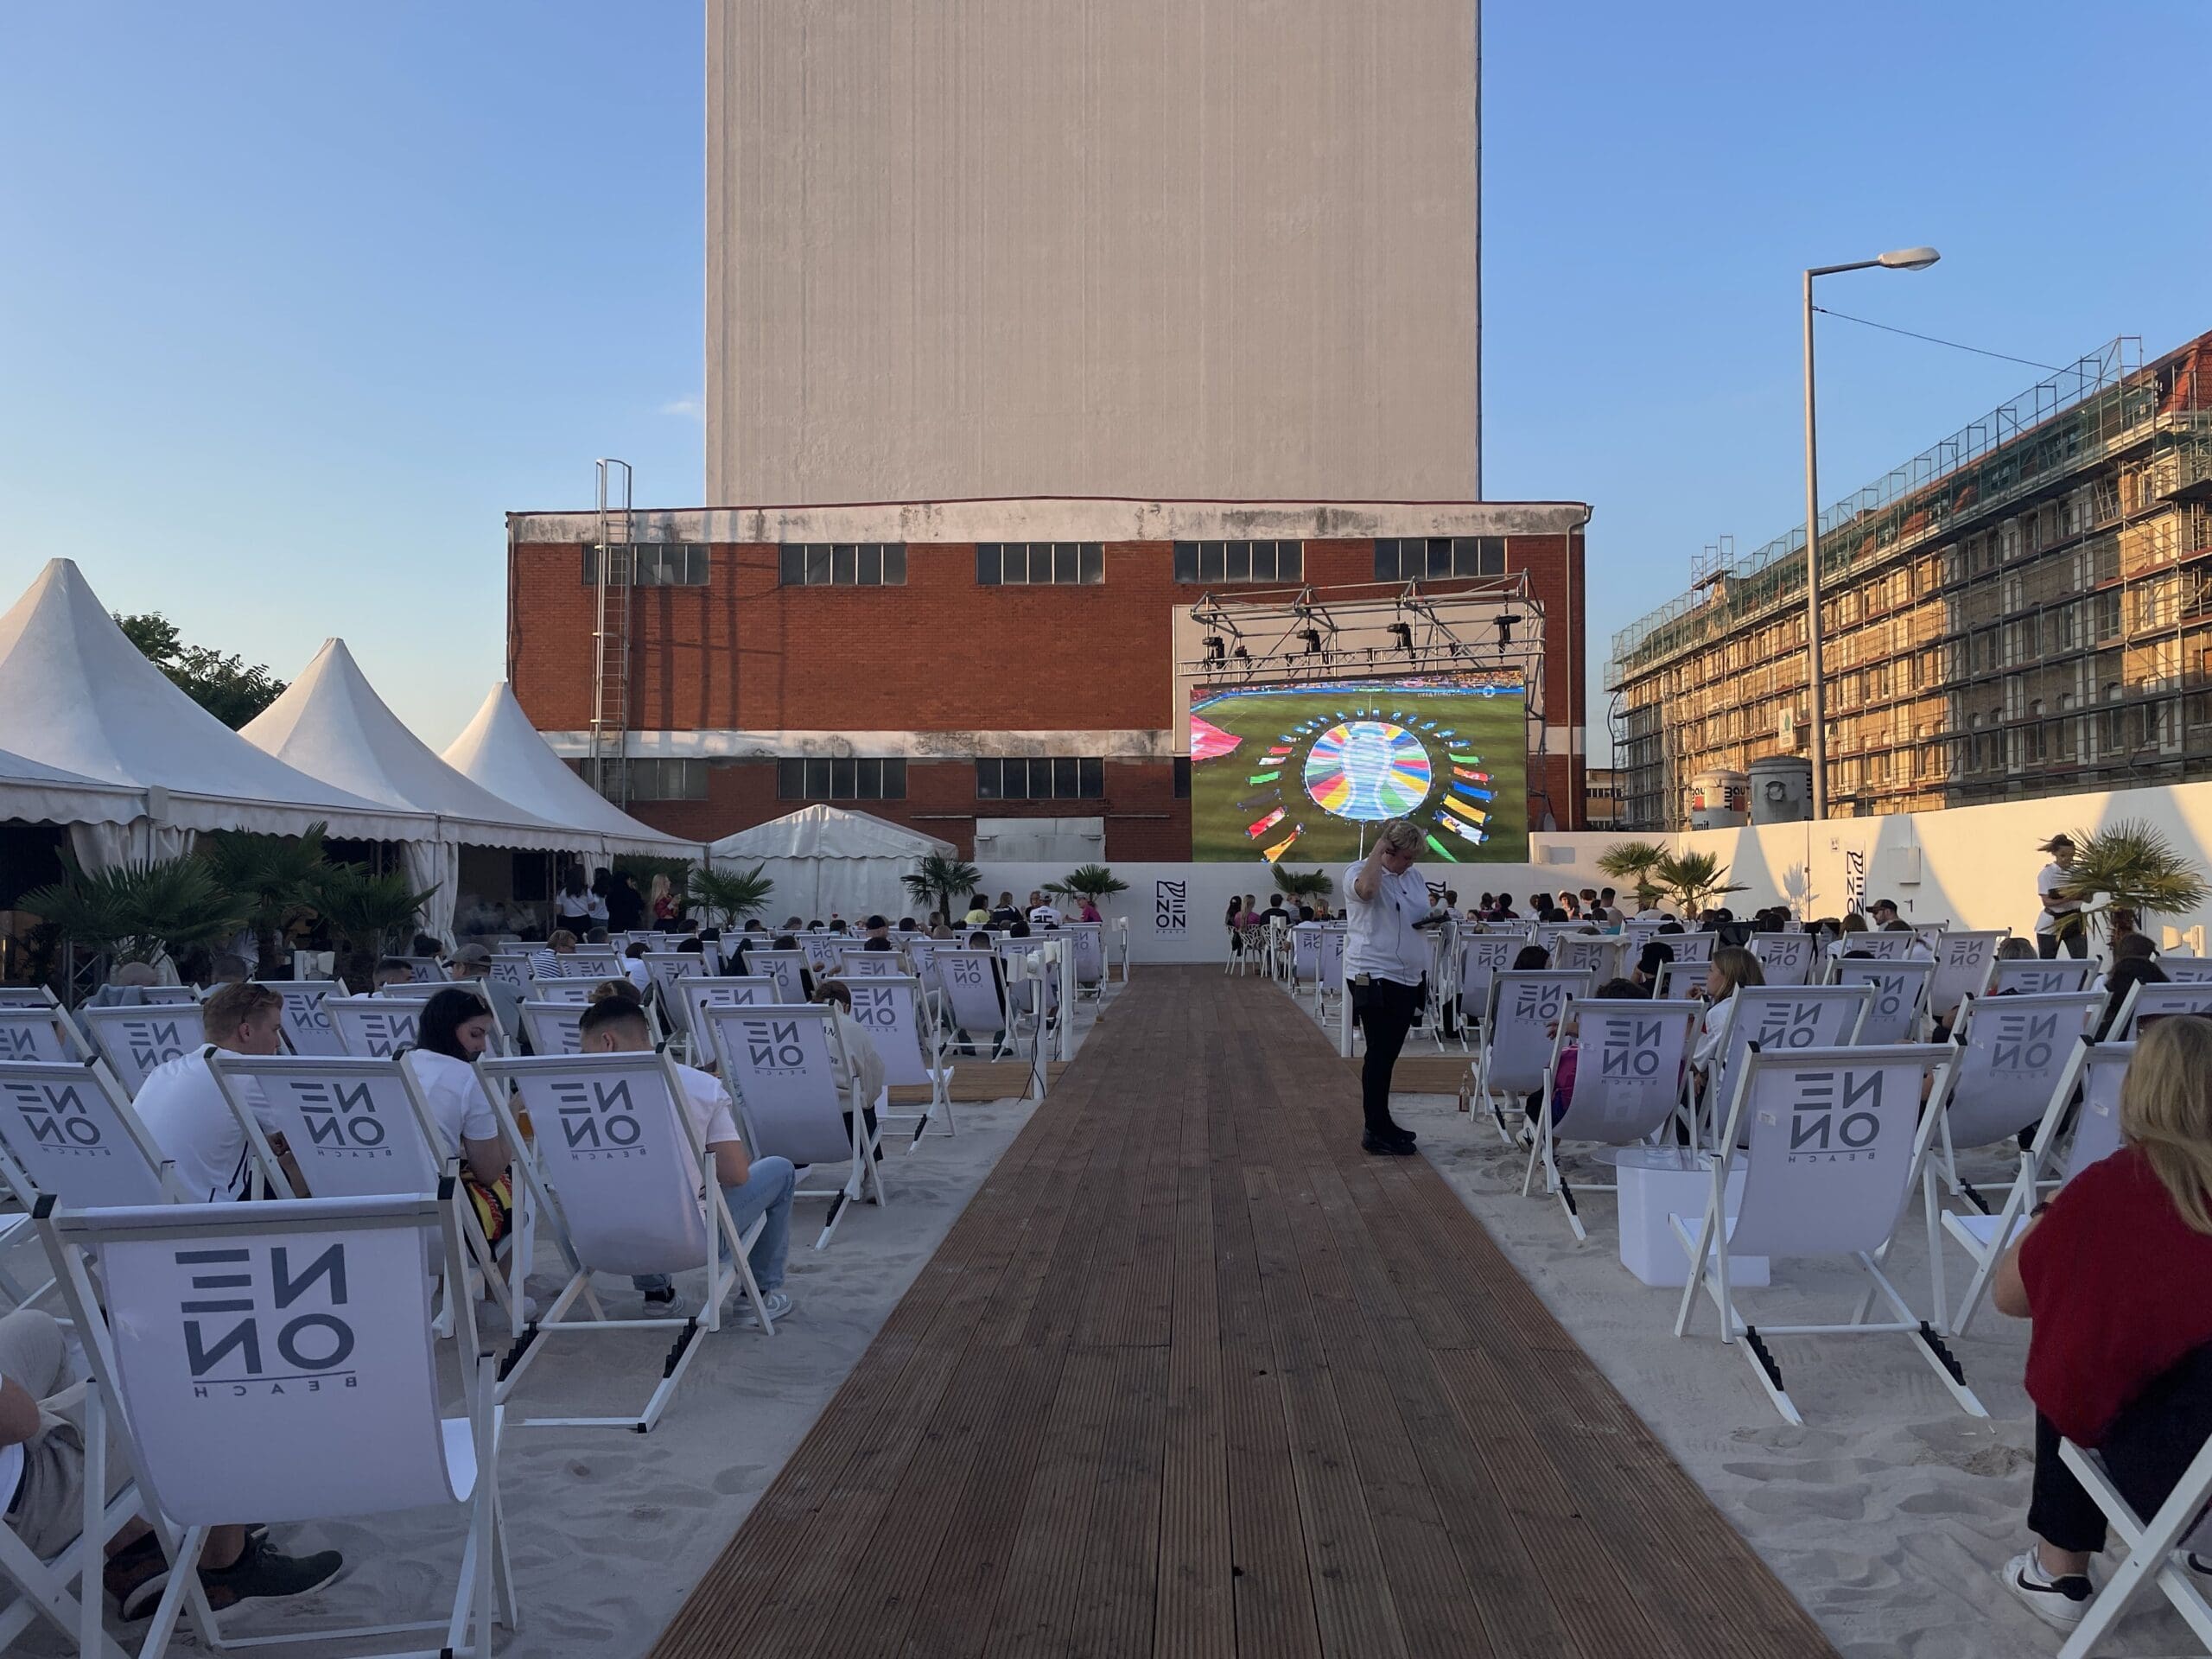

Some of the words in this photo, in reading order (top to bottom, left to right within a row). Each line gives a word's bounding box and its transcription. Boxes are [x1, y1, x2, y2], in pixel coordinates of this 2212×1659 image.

[1847, 876, 1864, 895] NE
[1157, 899, 1185, 912] NE
[1156, 914, 1185, 928] ON
